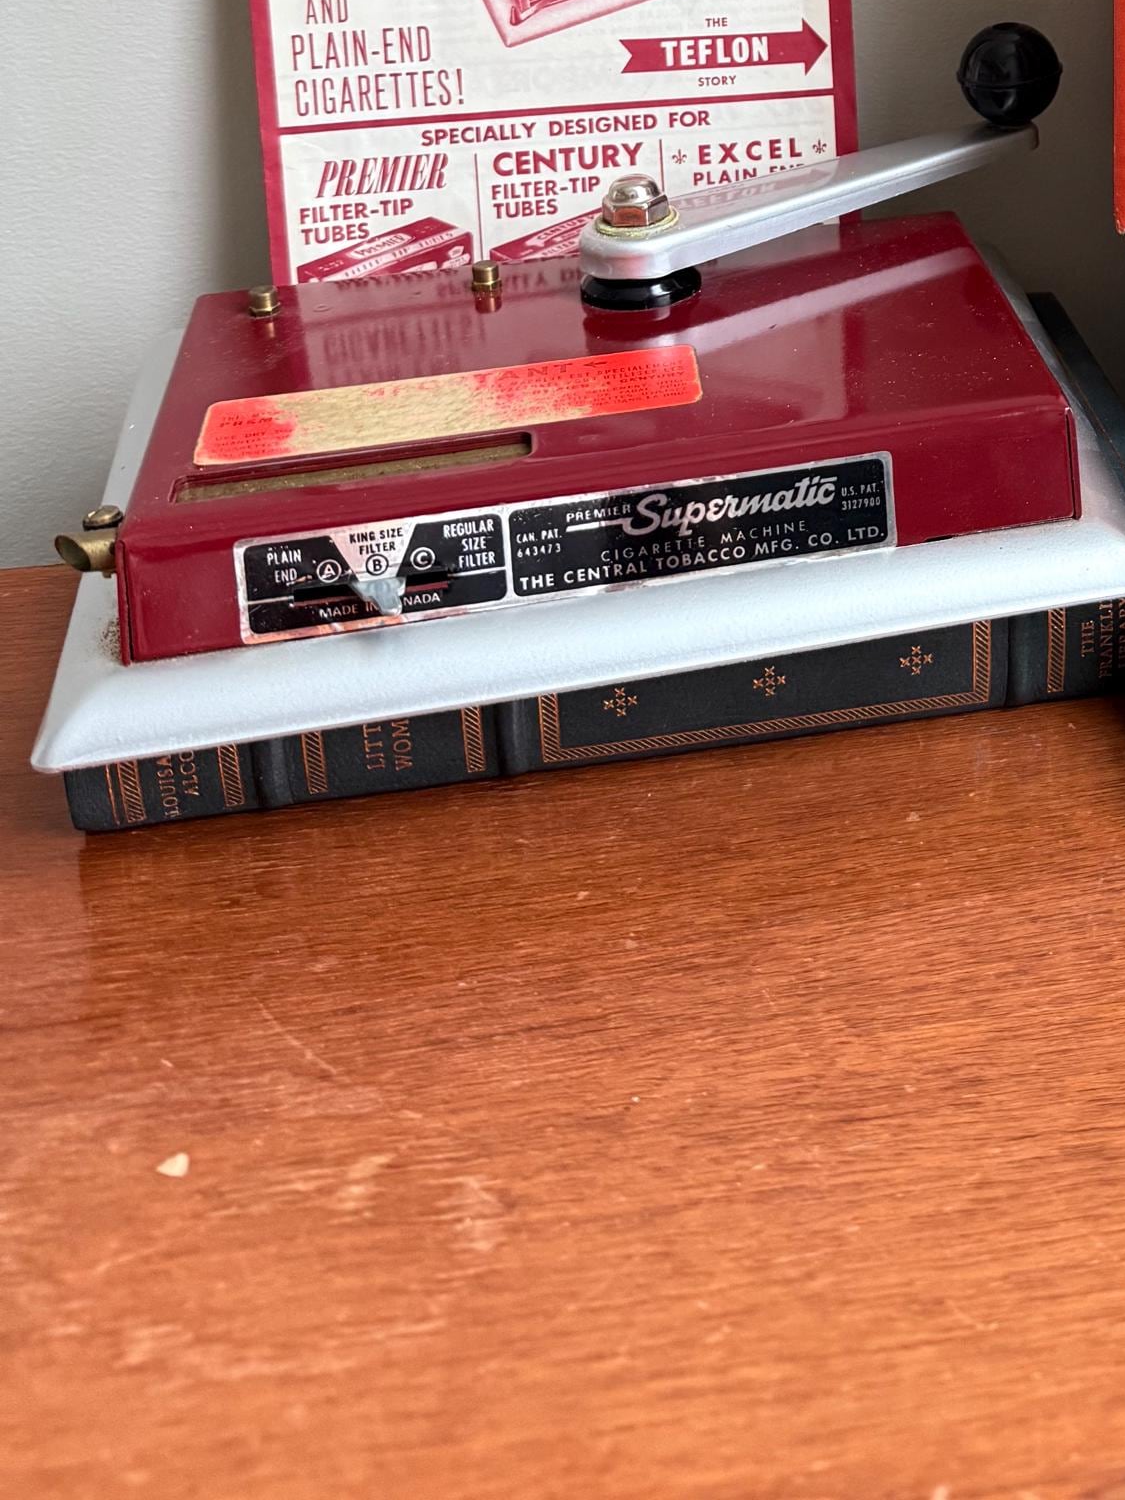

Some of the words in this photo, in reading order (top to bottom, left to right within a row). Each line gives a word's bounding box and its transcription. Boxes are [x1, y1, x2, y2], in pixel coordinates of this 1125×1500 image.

[704, 17, 729, 29] THE
[290, 26, 432, 72] PLAIN-END
[660, 35, 770, 68] TEFLON
[697, 74, 738, 89] STORY
[294, 68, 465, 118] CIGARETTES!
[420, 121, 536, 148] SPECIALLY
[548, 114, 658, 137] DESIGNED
[668, 110, 711, 130] FOR
[492, 142, 644, 177] CENTURY
[697, 137, 802, 165] EXCEL
[315, 153, 449, 198] PREMIER
[693, 167, 758, 186] PLAIN
[491, 176, 601, 201] FILTER-TIP
[299, 199, 415, 225] FILTER-TIP
[492, 198, 559, 220] TUBES
[301, 222, 371, 246] TUBES
[841, 485, 858, 497] U.S.
[860, 482, 880, 495] PAT.
[565, 503, 632, 523] PREMIER
[623, 476, 838, 537] Supermatic
[841, 496, 881, 511] 3127900
[349, 530, 377, 544] KING
[379, 527, 404, 541] SIZE
[443, 518, 496, 539] REGULAR
[516, 531, 538, 544] CAN.
[541, 528, 563, 542] PAT.
[359, 541, 397, 556] FILTER
[462, 535, 488, 552] SIZE
[516, 543, 562, 559] 643473
[601, 535, 706, 563] CIGARETTE
[720, 520, 807, 545] MACHINE
[266, 548, 302, 566] PLAIN
[458, 551, 497, 569] FILTER
[520, 573, 555, 591] THE
[563, 561, 648, 585] CENTRAL
[655, 545, 747, 571] TOBACCO
[754, 538, 800, 557] MFG.
[808, 531, 839, 548] CO.
[847, 525, 886, 542] LTD.
[274, 568, 298, 584] END
